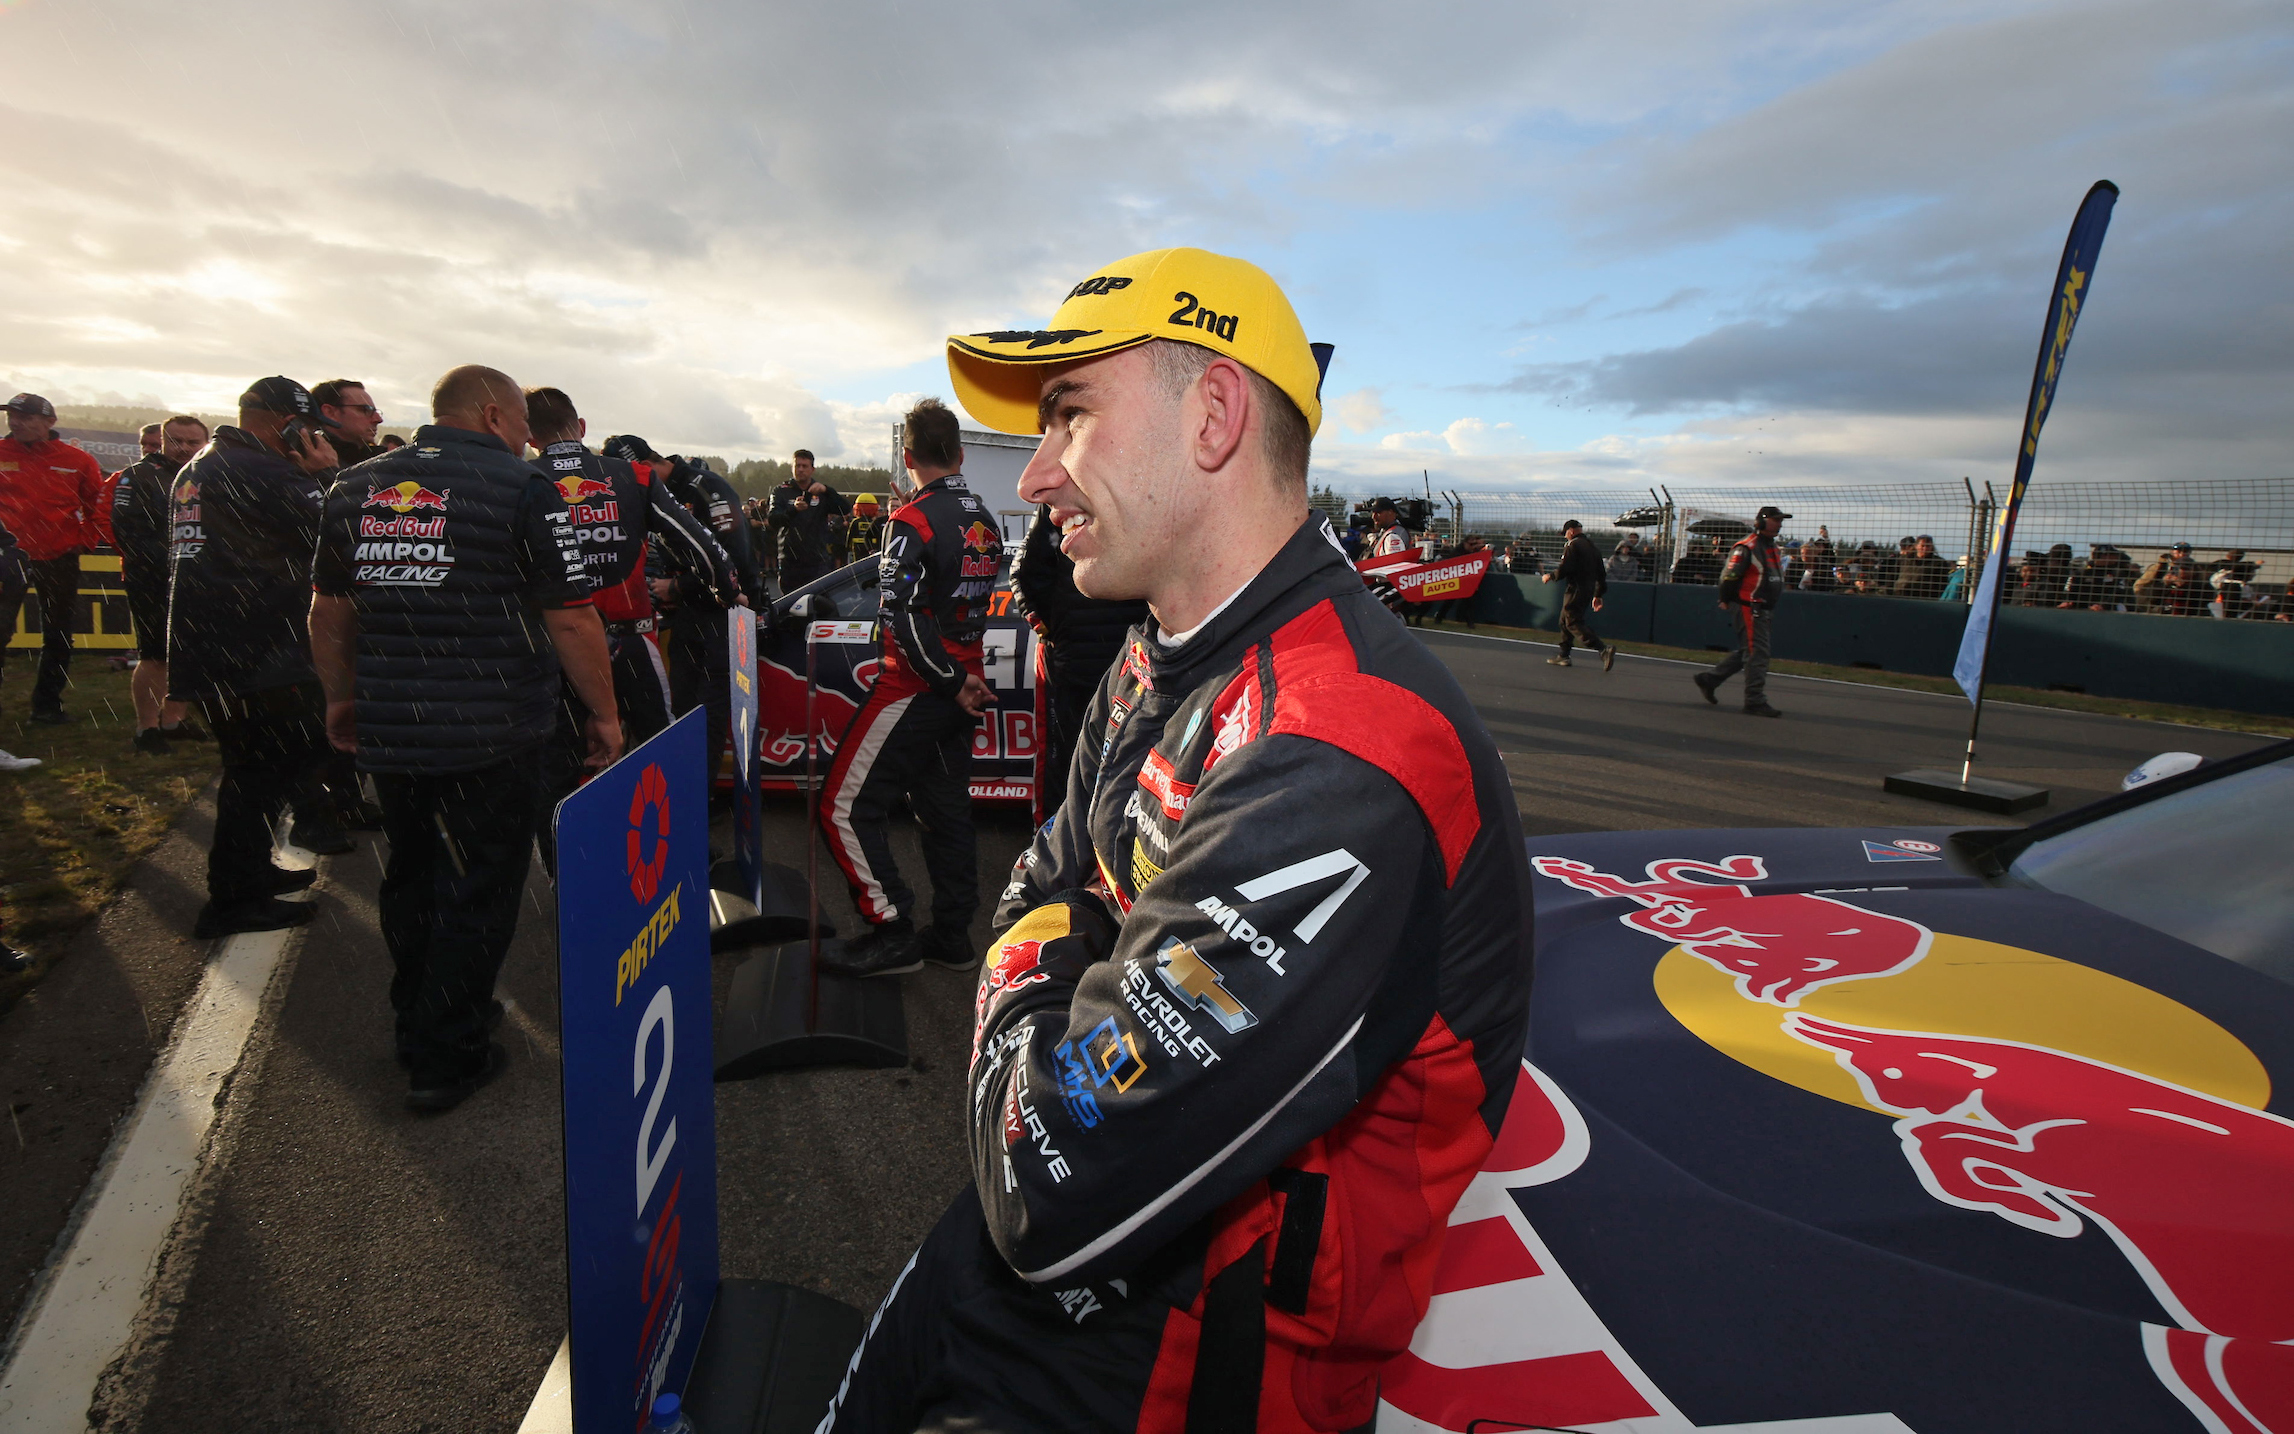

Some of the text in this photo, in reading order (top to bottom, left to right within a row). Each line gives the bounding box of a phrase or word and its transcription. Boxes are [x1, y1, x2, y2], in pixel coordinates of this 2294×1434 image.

[1168, 291, 1239, 343] 2nd
[553, 459, 582, 469] OMP
[961, 499, 977, 510] OMP
[360, 515, 447, 539] Red Bull
[575, 526, 627, 545] POL
[354, 542, 455, 563] AMPOL
[355, 564, 451, 581] RACING
[1398, 559, 1483, 590] SUPERCHEAP
[1426, 581, 1456, 594] AUTO
[740, 707, 748, 781] 1
[967, 785, 1028, 798] OLLAND
[615, 881, 682, 1008] PIRTEK
[1195, 895, 1287, 977] AMPOL
[1119, 977, 1181, 1058] RACING
[1123, 958, 1222, 1068] HEVROLET
[633, 984, 677, 1221] 2
[1015, 1025, 1073, 1184] RECURVE
